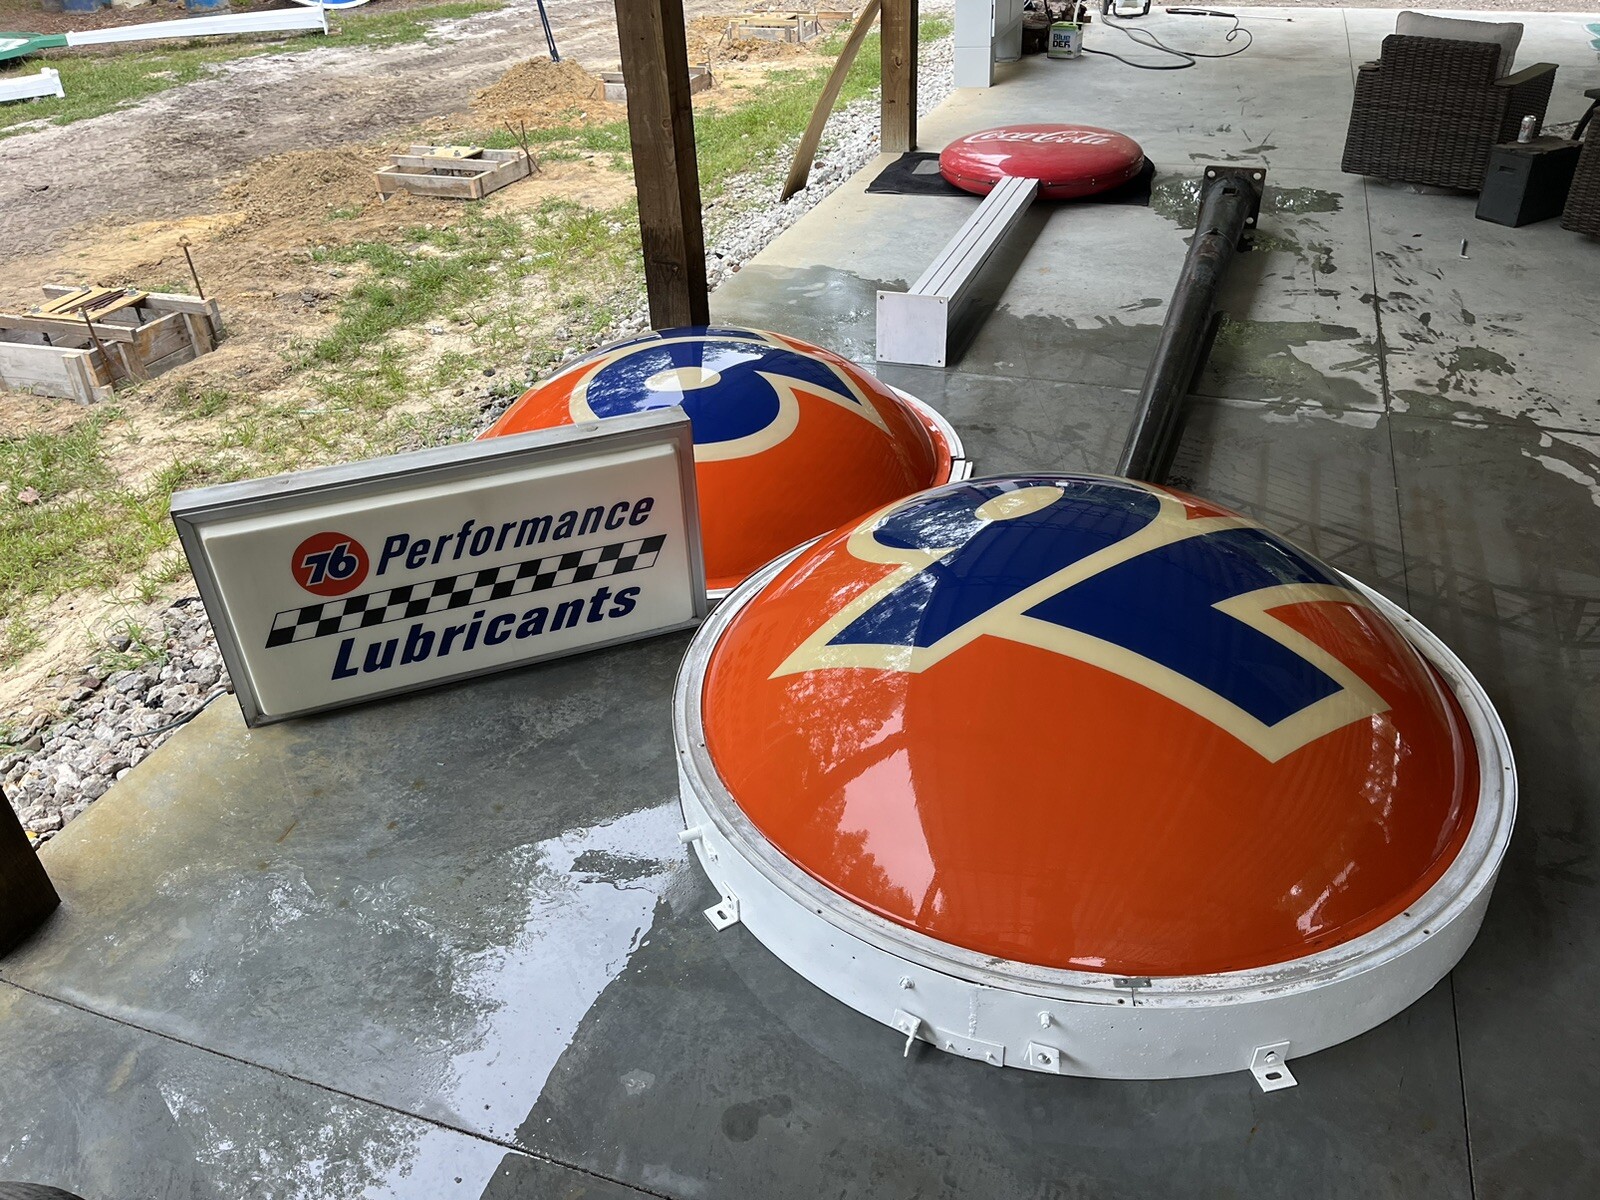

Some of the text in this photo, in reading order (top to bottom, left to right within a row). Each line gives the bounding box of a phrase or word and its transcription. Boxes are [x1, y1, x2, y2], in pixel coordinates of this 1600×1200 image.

[1053, 33, 1071, 41] Blue
[301, 497, 654, 587] 76 Performance
[331, 586, 641, 680] Lubricants
